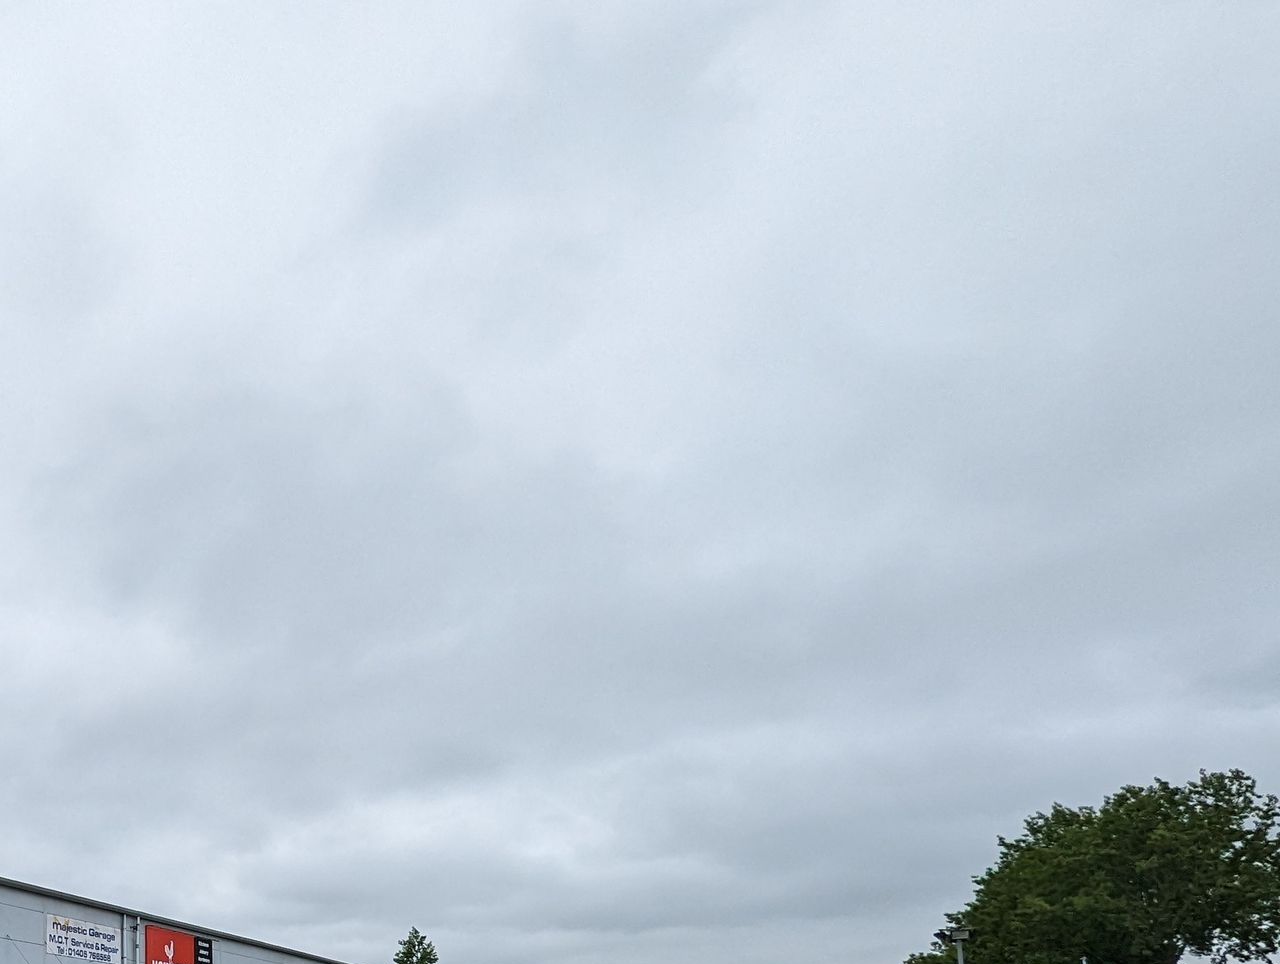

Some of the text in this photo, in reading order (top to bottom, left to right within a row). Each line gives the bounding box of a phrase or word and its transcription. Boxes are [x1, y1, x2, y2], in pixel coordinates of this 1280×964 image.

[88, 928, 115, 942] Garage
[70, 938, 94, 950] Service
[100, 943, 119, 954] Repair
